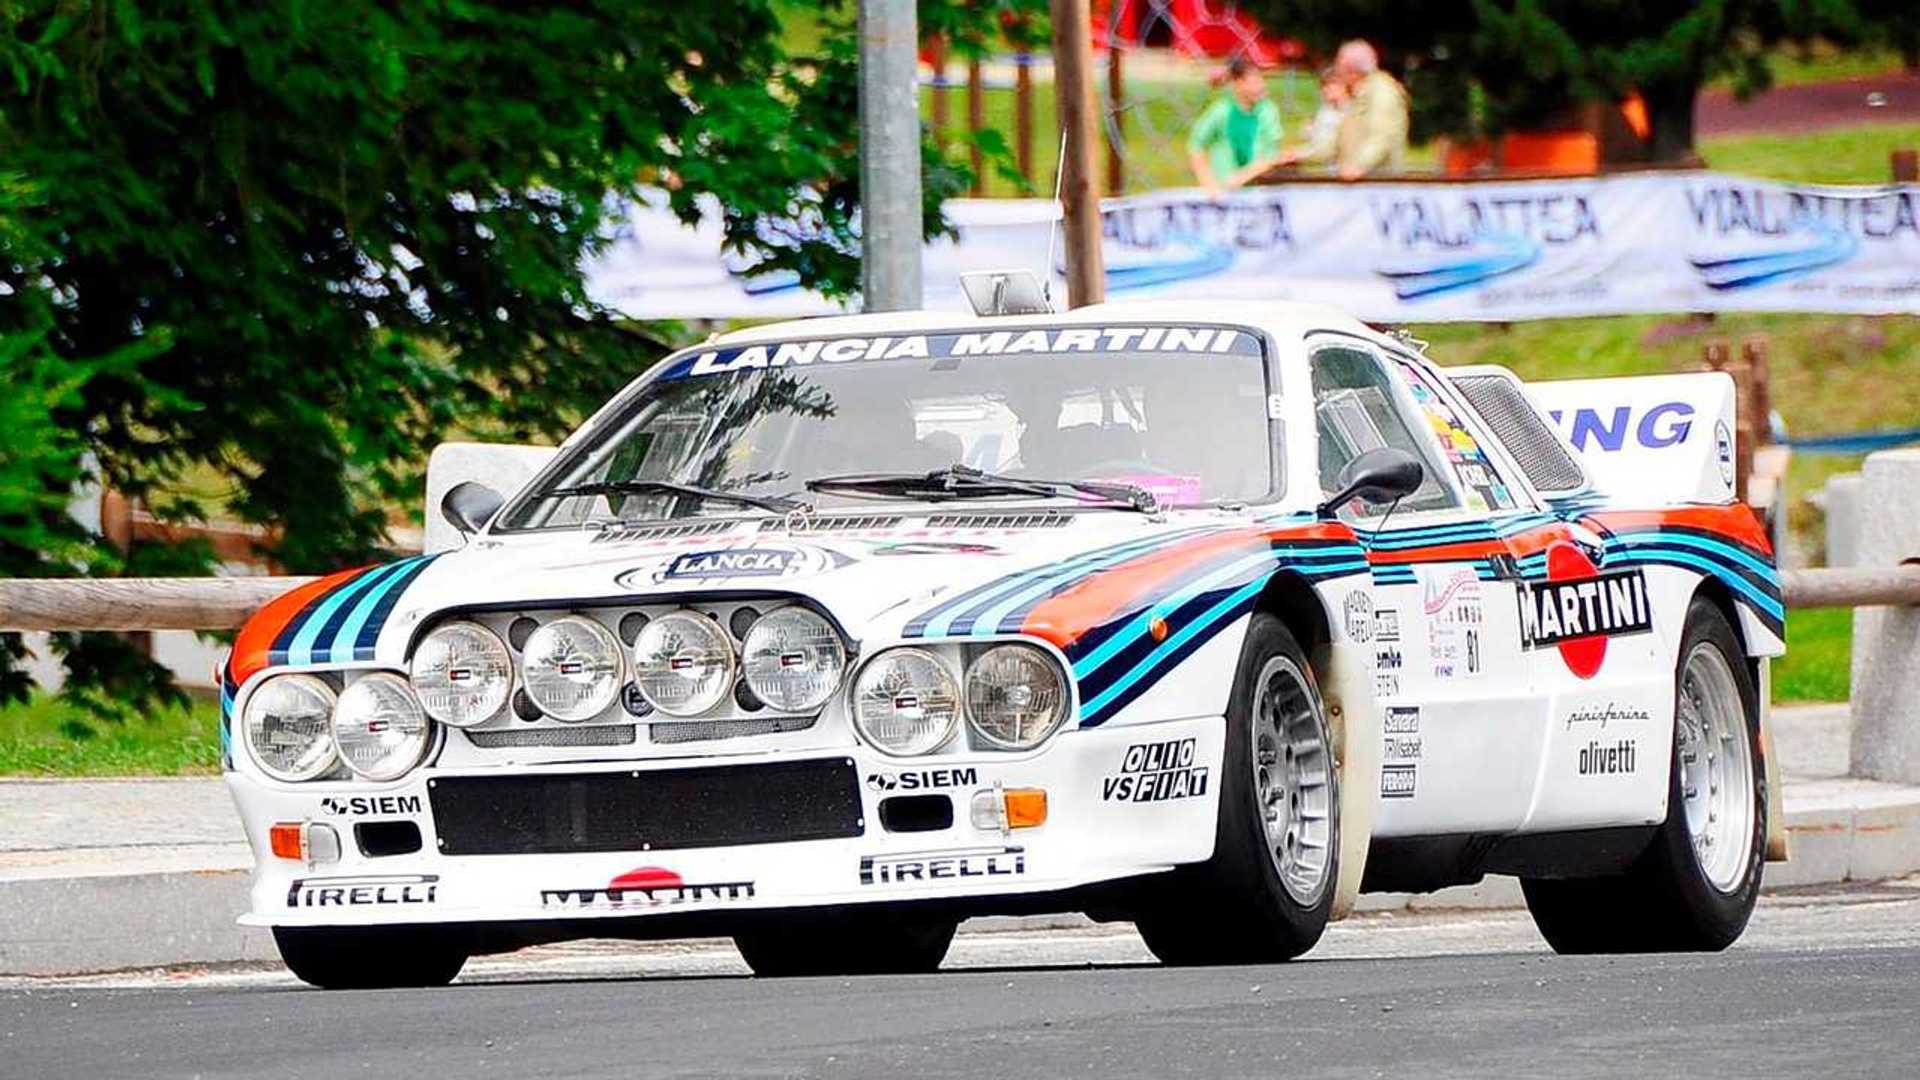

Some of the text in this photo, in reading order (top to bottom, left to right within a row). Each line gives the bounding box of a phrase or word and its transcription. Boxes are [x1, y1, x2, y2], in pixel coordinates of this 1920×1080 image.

[690, 327, 1239, 376] LANCIA MARTINI
[673, 553, 784, 573] LANCIA
[1519, 575, 1647, 642] MARTINI
[1466, 630, 1480, 673] 81
[1121, 739, 1196, 773] OLIO
[1579, 739, 1636, 774] olivetti
[900, 768, 978, 789] SIEM
[350, 796, 422, 815] SIEM
[860, 846, 1025, 885] PIRELLI
[287, 874, 440, 908] PIRELLI
